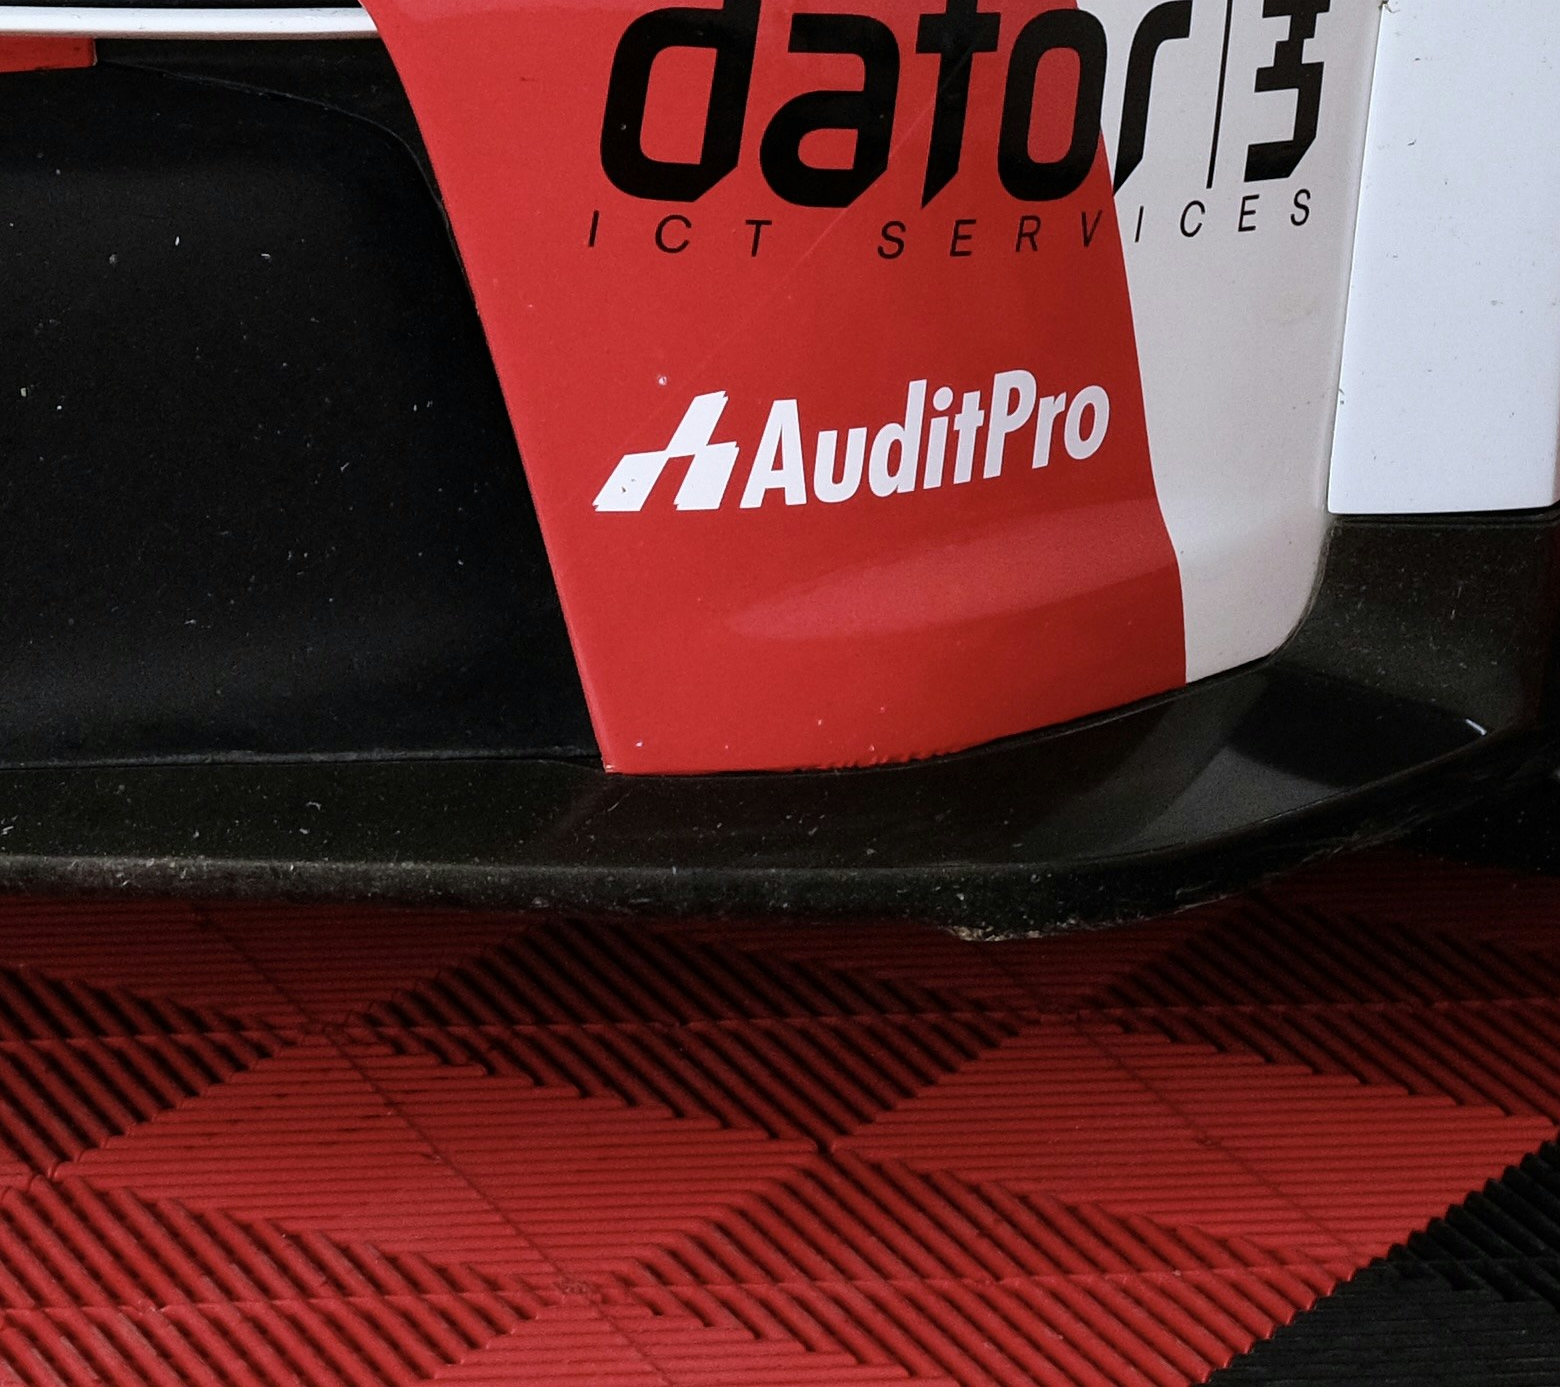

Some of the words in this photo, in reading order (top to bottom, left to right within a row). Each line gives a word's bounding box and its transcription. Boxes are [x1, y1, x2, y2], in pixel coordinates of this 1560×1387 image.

[584, 208, 770, 260] ICT
[876, 185, 1314, 261] SERVICES
[738, 368, 1113, 510] AuditPro
